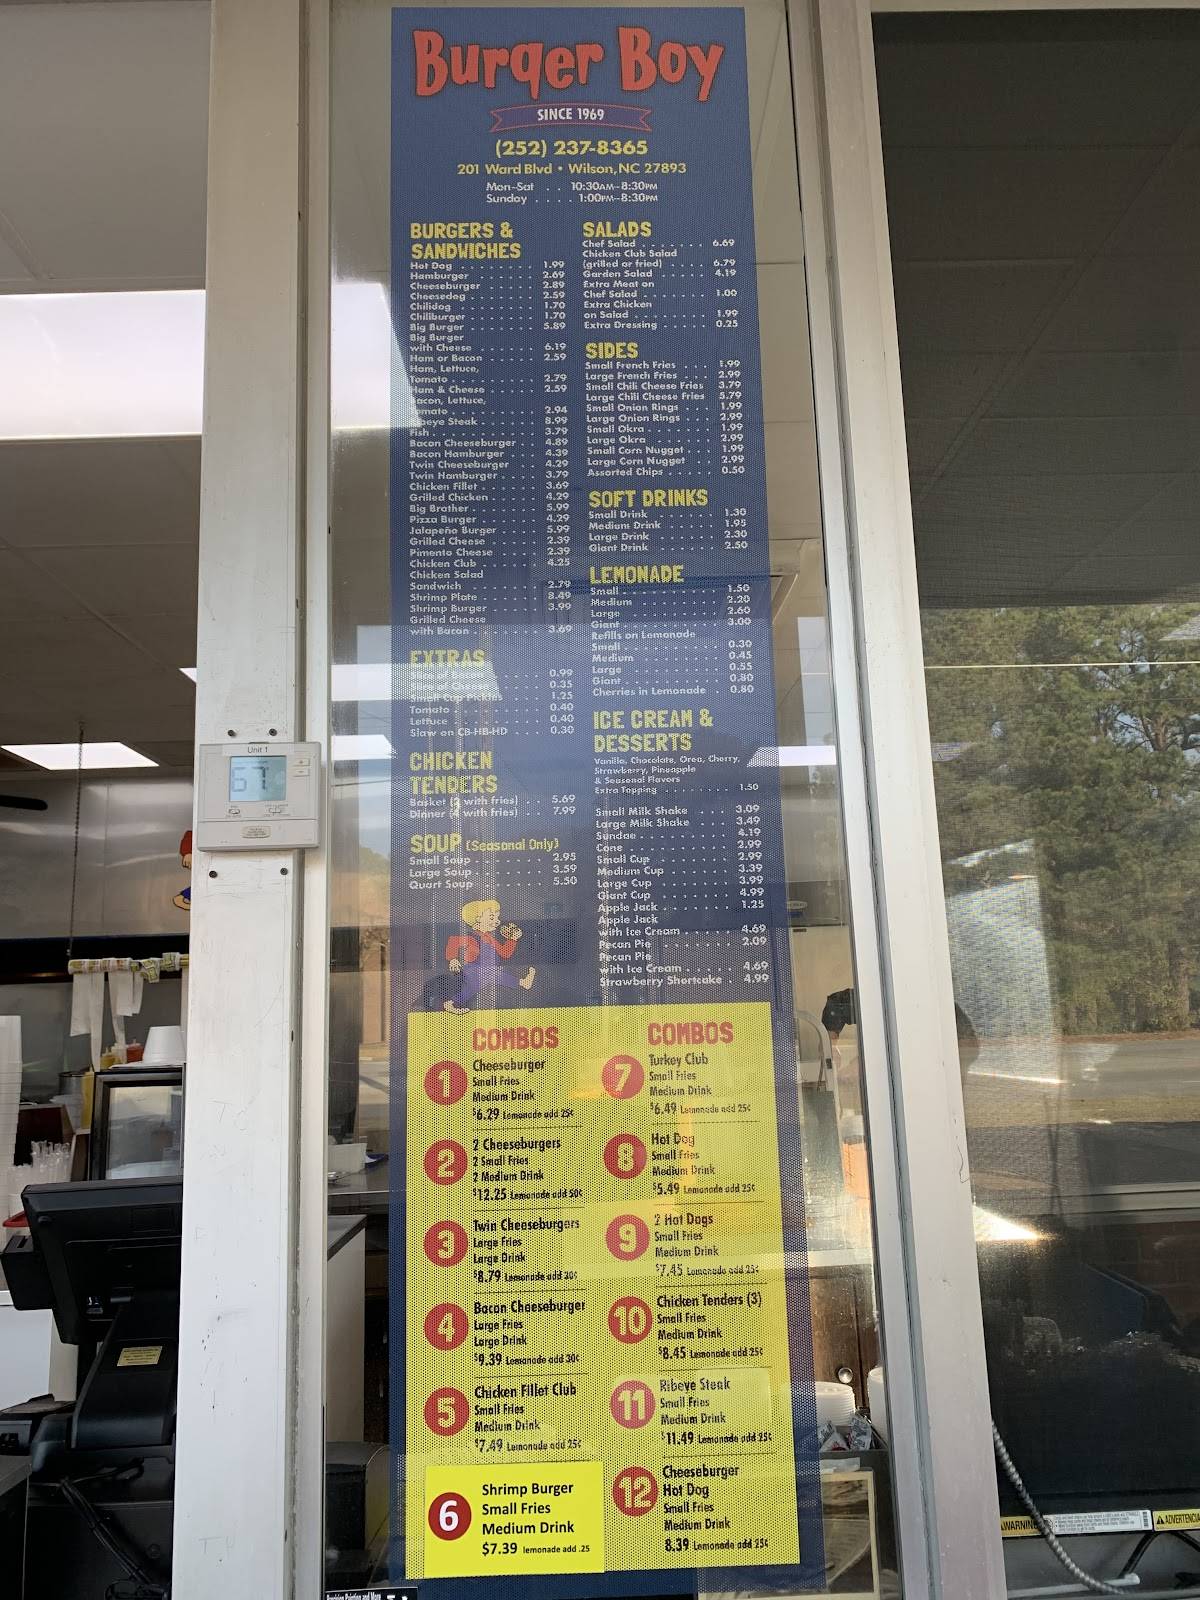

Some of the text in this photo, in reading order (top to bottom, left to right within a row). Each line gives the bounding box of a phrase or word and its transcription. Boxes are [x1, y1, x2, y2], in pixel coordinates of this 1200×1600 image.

[413, 26, 724, 102] Burger Boy
[537, 108, 604, 121] SINCE 1969
[496, 139, 648, 158] (252) 237-8365
[457, 163, 686, 175] 201 Ward Blvd Wilson, NC 27893
[486, 193, 527, 205] Sunday
[410, 222, 513, 239] BURGERS &
[583, 221, 651, 238] SALADS
[582, 239, 735, 248] Chef Salad 6.69
[411, 243, 521, 259] SANDWICHES
[410, 262, 427, 270] Hot
[431, 262, 452, 272] Dog
[583, 269, 736, 278] Garden Salad 4.19
[410, 271, 565, 282] Hamburger 2.69
[410, 281, 565, 292] Cheeseburger 2.89
[410, 291, 565, 302] Cheesedog 2.59
[410, 301, 565, 312] Chilidog 1.70
[410, 313, 465, 322] Chiliburger
[410, 324, 427, 333] Big
[429, 324, 464, 333] Burger
[585, 342, 638, 359] SIDES
[585, 372, 614, 382] Large
[617, 372, 650, 380] French
[409, 438, 568, 448] Bacon Cheeseburger 4.89
[589, 489, 708, 507] SOFT DRINKS
[409, 515, 477, 525] Pizza Burger
[589, 508, 746, 519] Small Drink 1.30
[409, 525, 570, 537] Jalapeño Burger 5.99
[589, 533, 617, 542] Large
[724, 530, 747, 538] 2.30
[409, 560, 450, 568] Chicken
[454, 560, 476, 568] Club
[589, 565, 684, 584] LEMONADE
[592, 688, 635, 696] Cherries
[652, 687, 706, 695] Lemonade
[730, 685, 754, 693] 0.80
[593, 708, 713, 729] ICE CREAM &
[594, 733, 692, 752] DESSERTS
[409, 751, 493, 771] CHICKEN
[409, 775, 498, 795] TENDERS
[595, 805, 759, 817] Small Milk Shake 3.09
[410, 833, 559, 854] SOUP (Seasonal Only)
[409, 864, 577, 879] Large Soup 3.59
[599, 974, 769, 988] Strawberry Shortcake 4.99
[472, 1026, 559, 1051] COMBOS
[648, 1022, 734, 1046] COMBOS
[473, 1059, 546, 1073] Cheeseburger
[649, 1052, 708, 1068] Turkey Club
[439, 1069, 451, 1098] 1
[615, 1063, 631, 1092] 7
[473, 1091, 535, 1102] Medium Drink
[473, 1108, 500, 1120] $6.29
[650, 1103, 677, 1115] $6.49
[473, 1137, 561, 1151] 2 Cheeseburgers
[651, 1133, 695, 1146] Hot Dog
[437, 1149, 455, 1177] 2
[618, 1143, 634, 1171] 8
[473, 1188, 507, 1201] $12.25
[653, 1183, 680, 1196] $5.49
[684, 1185, 723, 1194] Lemonade
[725, 1184, 740, 1193] add
[473, 1218, 579, 1233] Twin Cheeseburgers
[654, 1213, 713, 1227] 2 Hot Dogs
[437, 1230, 455, 1259] 3
[619, 1223, 637, 1253] 9
[474, 1271, 500, 1283] $8.79
[657, 1292, 762, 1308] Chicken Tenders (3)
[474, 1300, 585, 1315] Bacon Cheeseburger
[614, 1305, 647, 1335] 10
[438, 1313, 455, 1342] 4
[659, 1347, 686, 1359] $8.45
[690, 1350, 730, 1359] Lemonade
[733, 1349, 748, 1357] add
[474, 1383, 576, 1399] Chicken Fillet Club
[660, 1377, 730, 1394] Ribeye Steak
[474, 1404, 524, 1415] Small Fries
[618, 1390, 645, 1420] 11
[437, 1397, 455, 1428] 5
[662, 1464, 740, 1479] Cheeseburger
[482, 1483, 573, 1497] Shrimp Burger
[619, 1476, 651, 1508] 12
[663, 1484, 709, 1498] Hot Dog
[439, 1500, 459, 1532] 6
[482, 1503, 551, 1515] Small Fries
[482, 1521, 574, 1535] Medium Drink
[482, 1543, 590, 1556] $7.39 lemonade add .25
